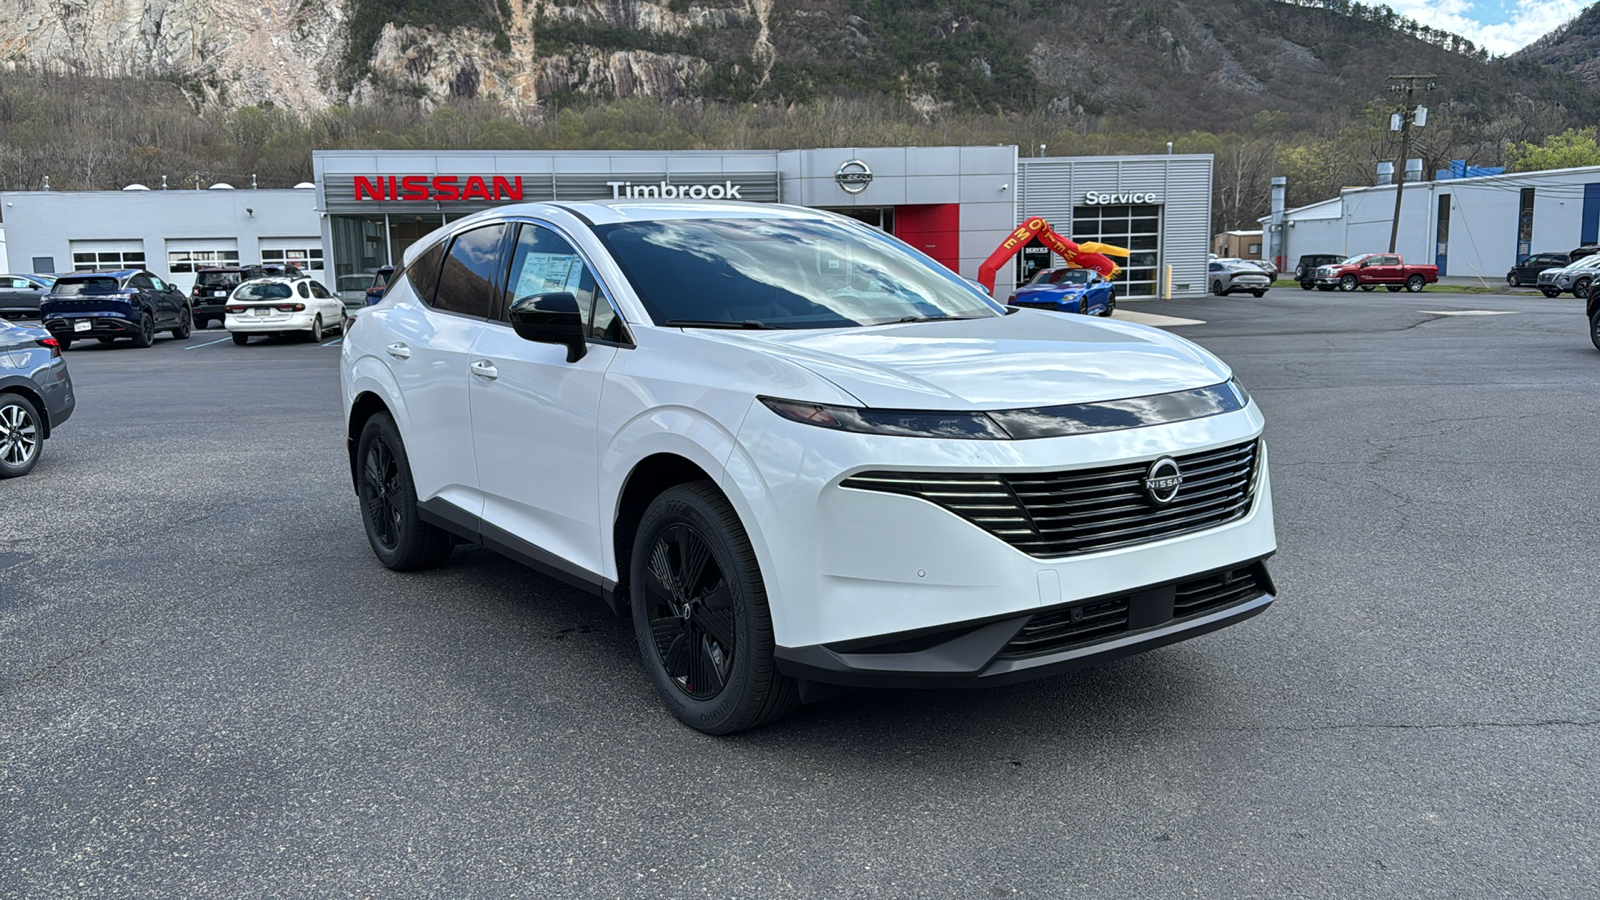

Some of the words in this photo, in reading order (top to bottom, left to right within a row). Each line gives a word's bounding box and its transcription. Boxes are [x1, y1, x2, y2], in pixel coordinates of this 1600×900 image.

[354, 176, 523, 200] NISSAN
[606, 180, 742, 199] Timbrook
[1085, 191, 1156, 205] Service
[1147, 477, 1183, 489] NISSAN
[700, 697, 730, 722] KUMHO
